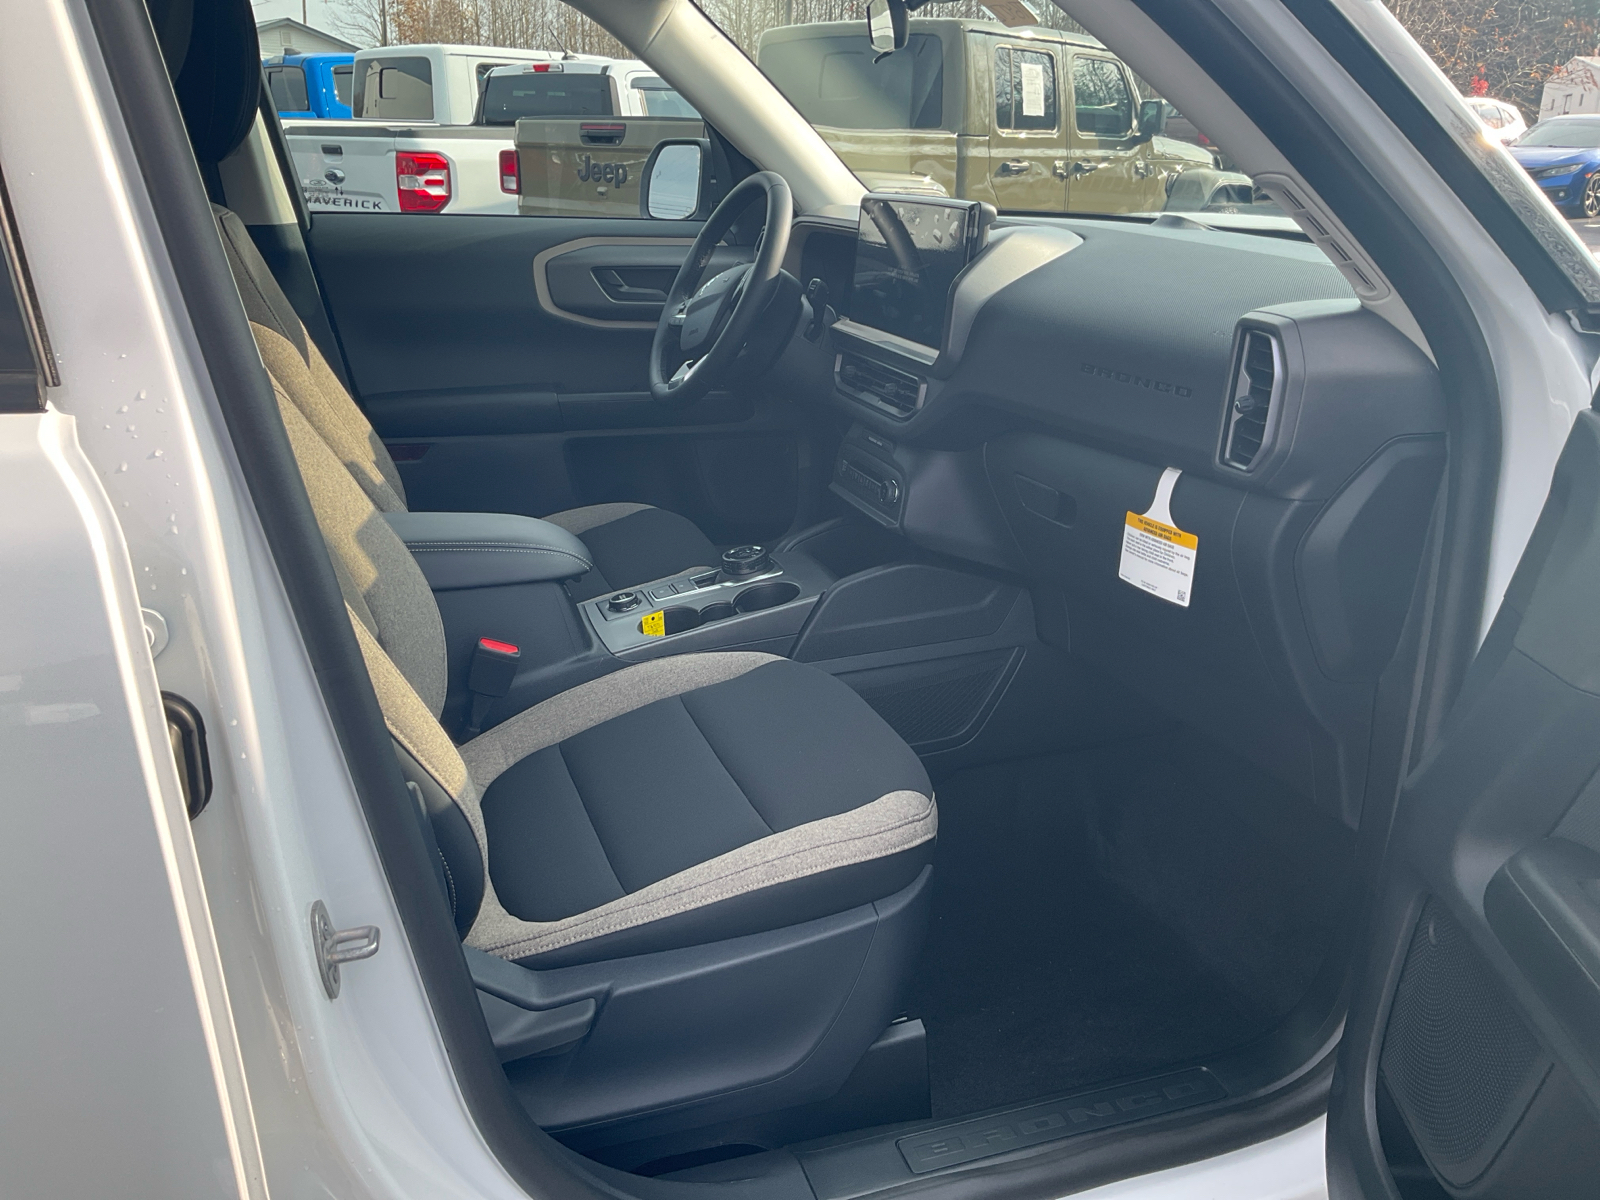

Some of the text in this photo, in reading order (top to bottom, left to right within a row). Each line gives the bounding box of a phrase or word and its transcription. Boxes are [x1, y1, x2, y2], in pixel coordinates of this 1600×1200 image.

[577, 155, 628, 189] Jeep
[306, 196, 382, 210] MAVERICK
[1080, 362, 1193, 399] BRONCO
[913, 1078, 1208, 1164] BRONCO
